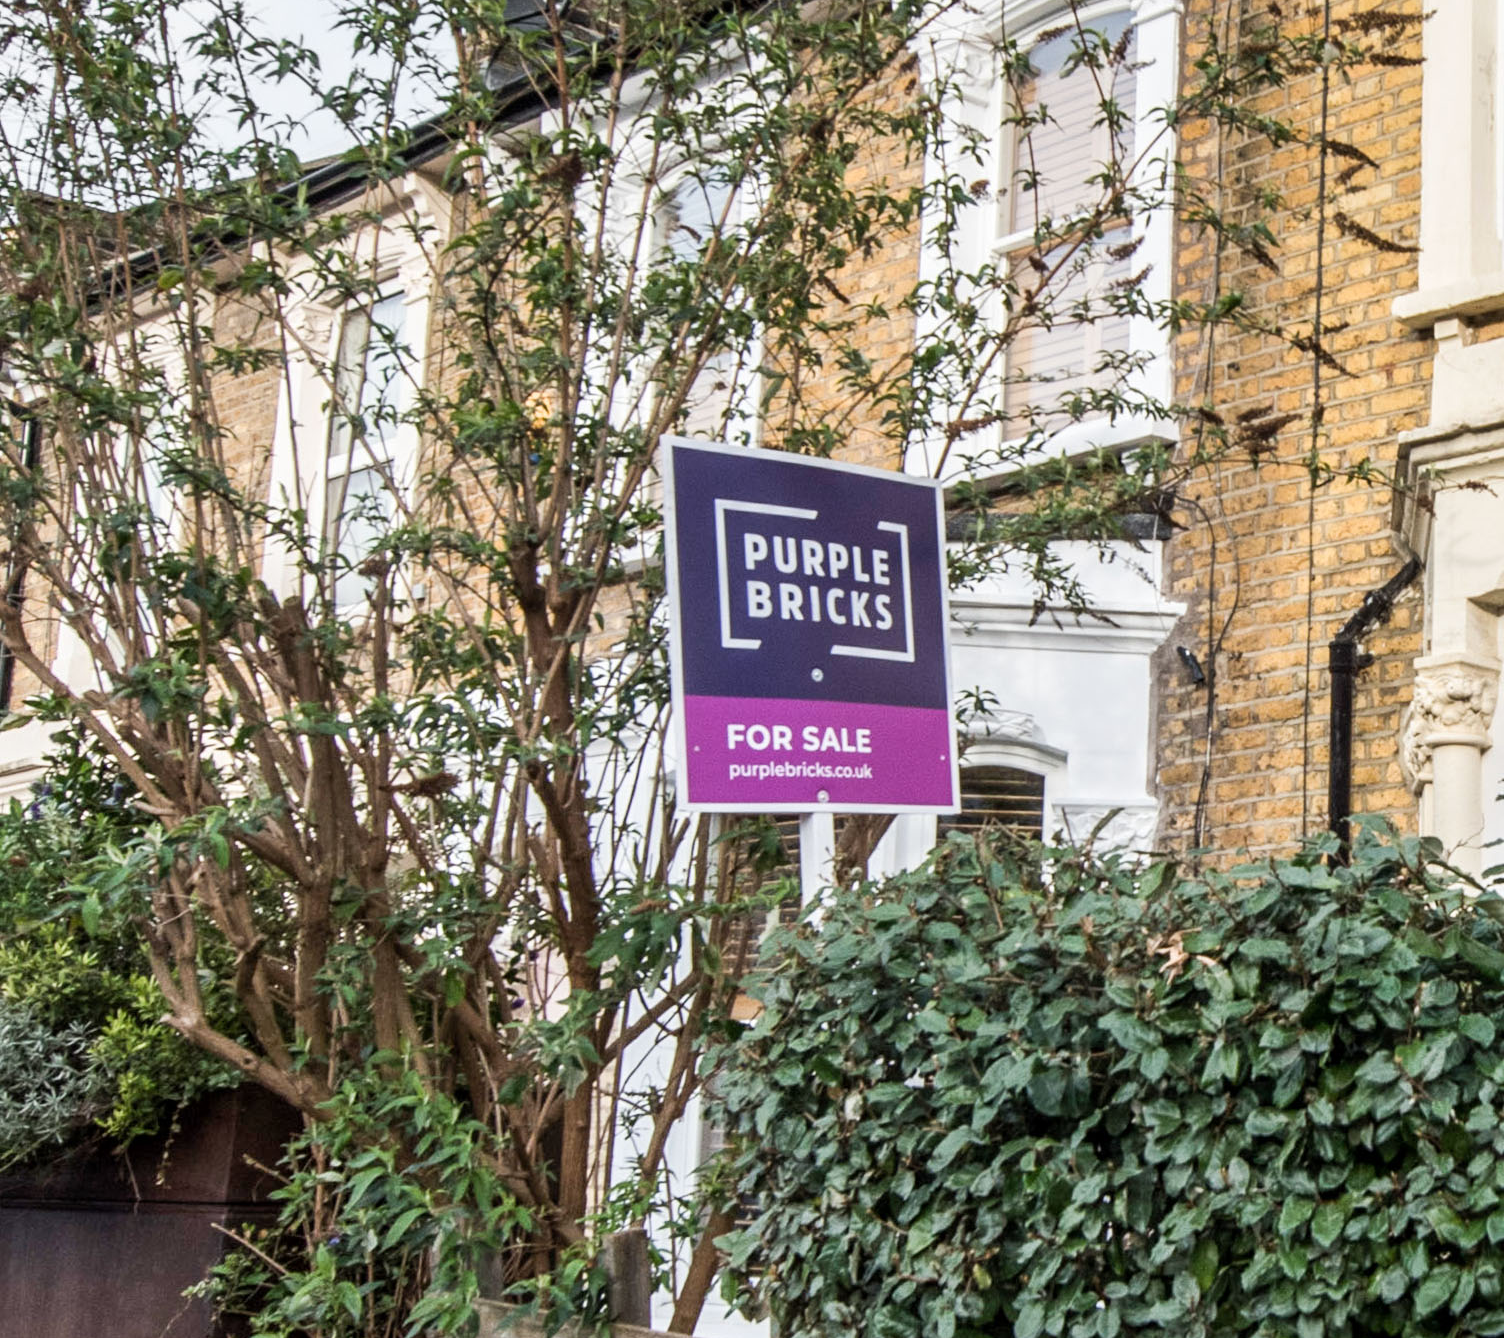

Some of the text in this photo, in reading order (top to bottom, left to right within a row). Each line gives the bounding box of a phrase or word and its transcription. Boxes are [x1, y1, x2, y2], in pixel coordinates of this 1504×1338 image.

[744, 532, 891, 586] PURPLE
[746, 580, 893, 631] BRICKS
[727, 724, 873, 754] FOR SALE
[729, 761, 873, 781] purplebricks.co.uk
